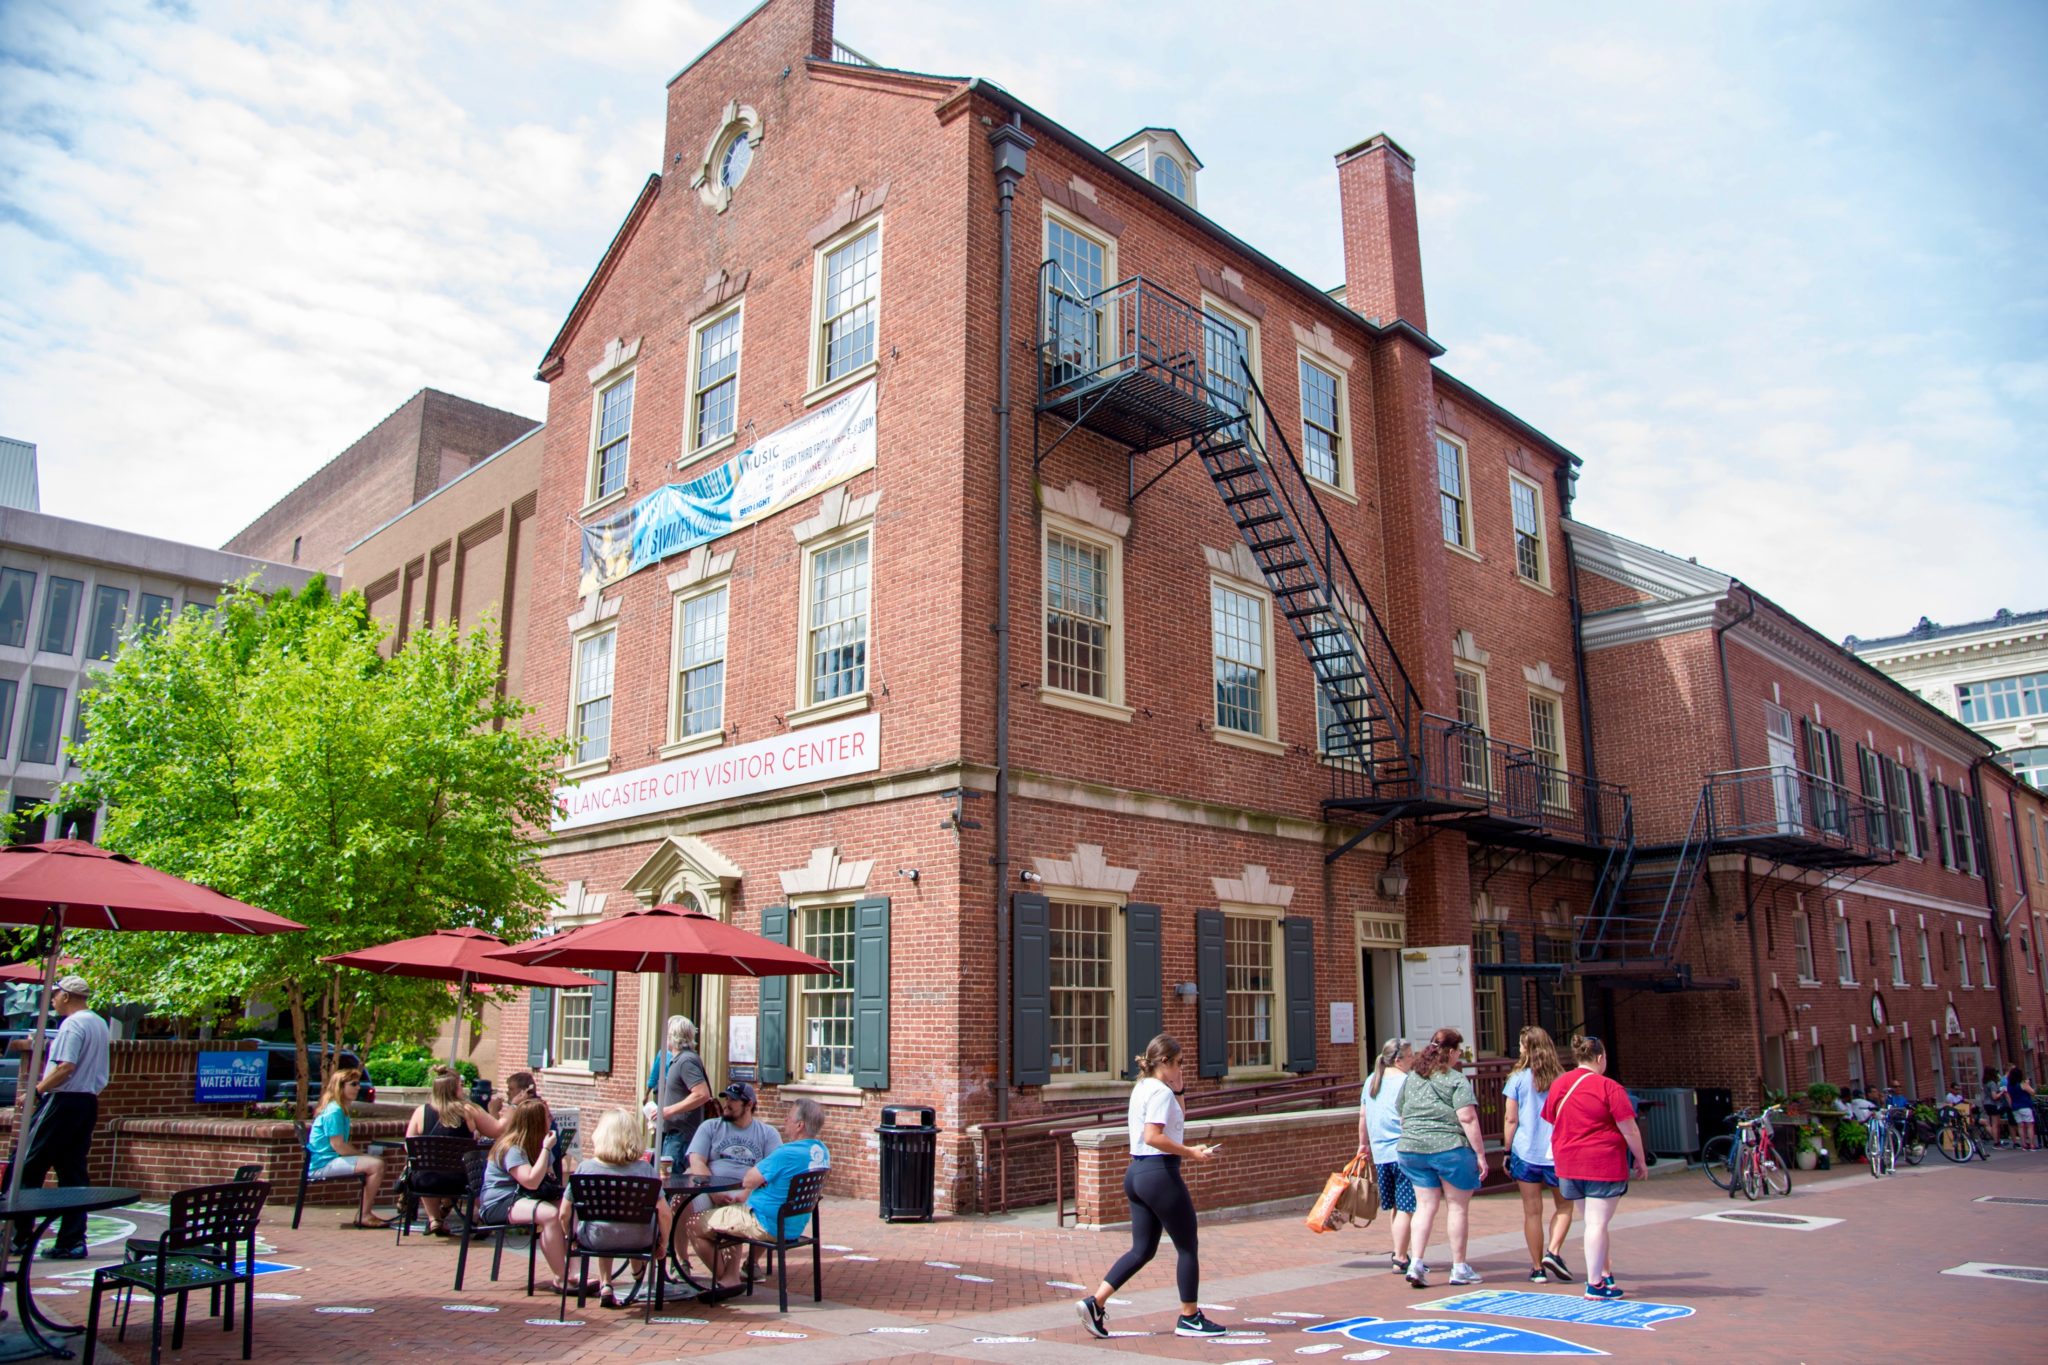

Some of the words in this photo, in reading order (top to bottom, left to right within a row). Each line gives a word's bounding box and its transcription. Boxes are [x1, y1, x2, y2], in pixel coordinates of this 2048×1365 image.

[782, 454, 797, 472] EVERY
[798, 447, 813, 461] THIRD
[739, 504, 753, 517] BUD
[753, 497, 771, 511] LIGHT
[573, 777, 659, 815] LANCASTER
[663, 767, 700, 796] CITY
[704, 751, 775, 787] VISITOR
[782, 731, 865, 771] CENTER
[200, 1076, 232, 1088] WATER
[233, 1076, 260, 1088] WEEK
